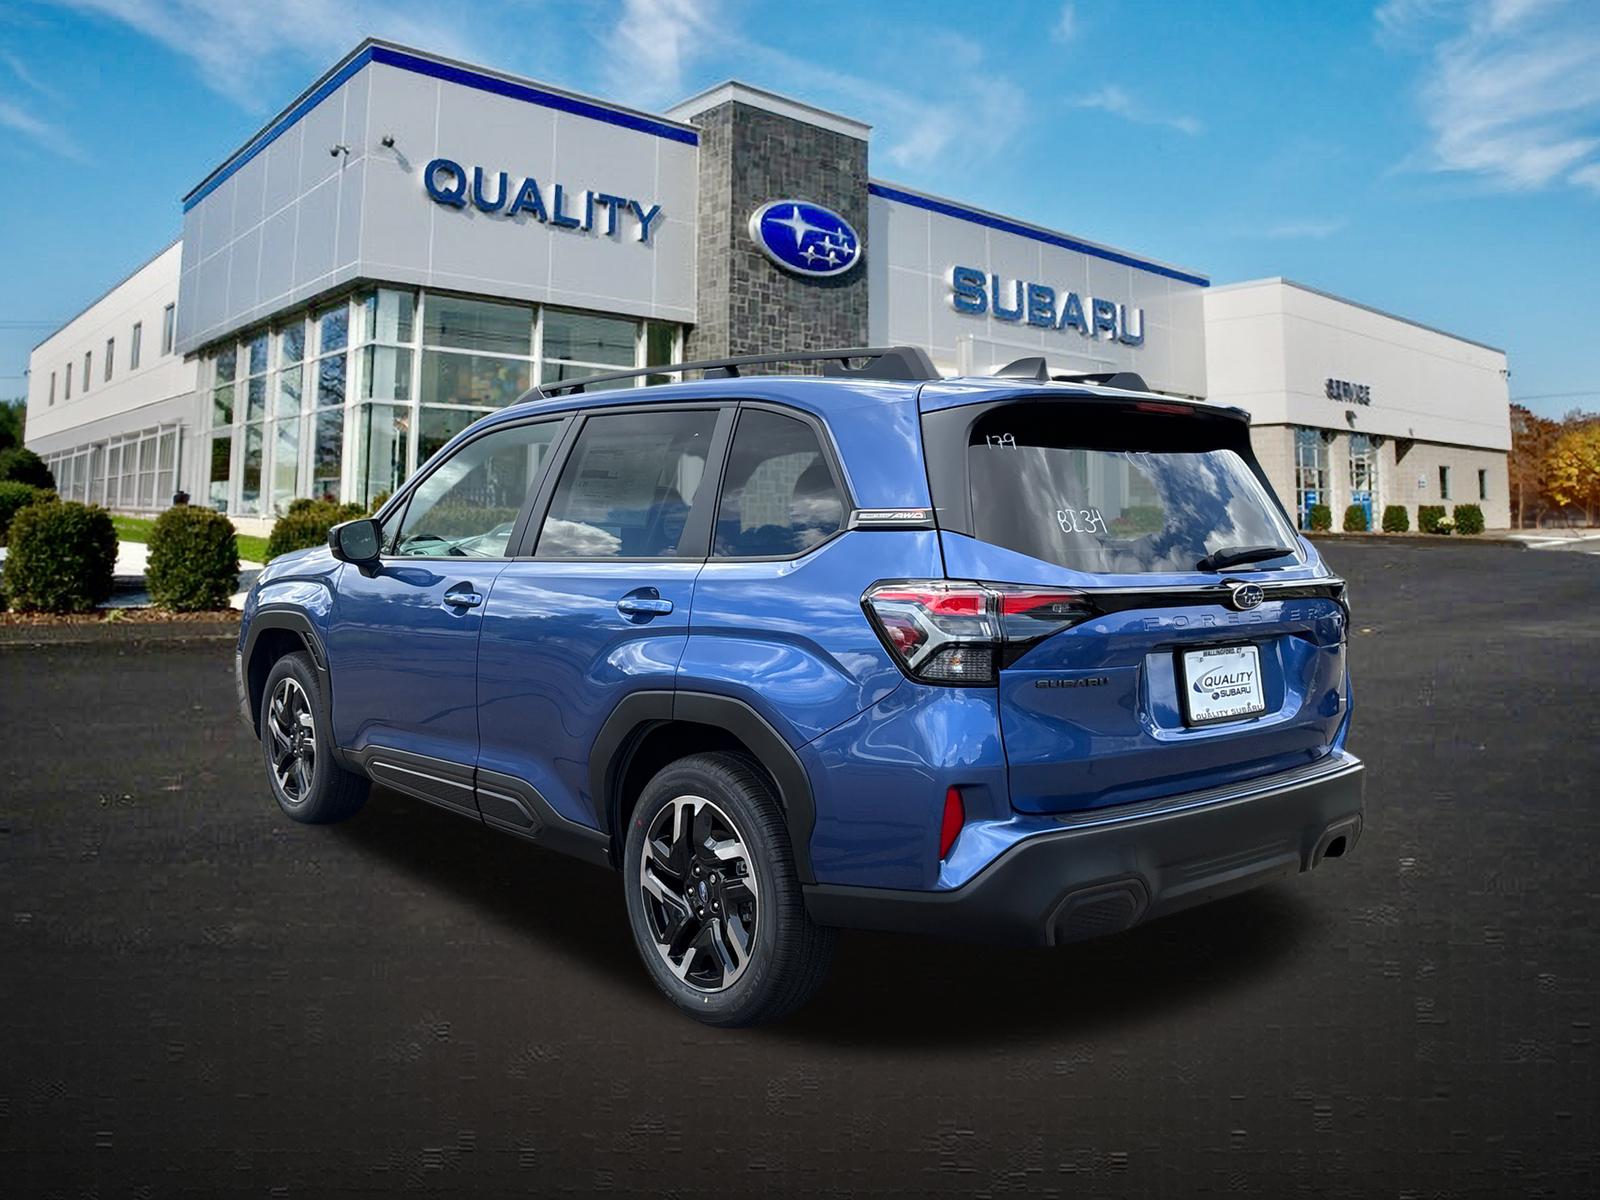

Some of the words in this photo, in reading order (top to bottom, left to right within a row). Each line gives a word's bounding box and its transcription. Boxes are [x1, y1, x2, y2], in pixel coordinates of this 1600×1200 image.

[423, 157, 661, 242] QUALITY
[949, 265, 1145, 346] SUBARU
[985, 432, 1017, 450] 179
[891, 511, 924, 520] AWD
[1143, 608, 1320, 632] FORESTER
[1034, 677, 1109, 689] SUBARU
[1204, 671, 1253, 687] QUALITY
[1220, 686, 1252, 698] SUBARU
[1196, 708, 1229, 720] QUALITY
[1231, 703, 1263, 715] SUBARU
